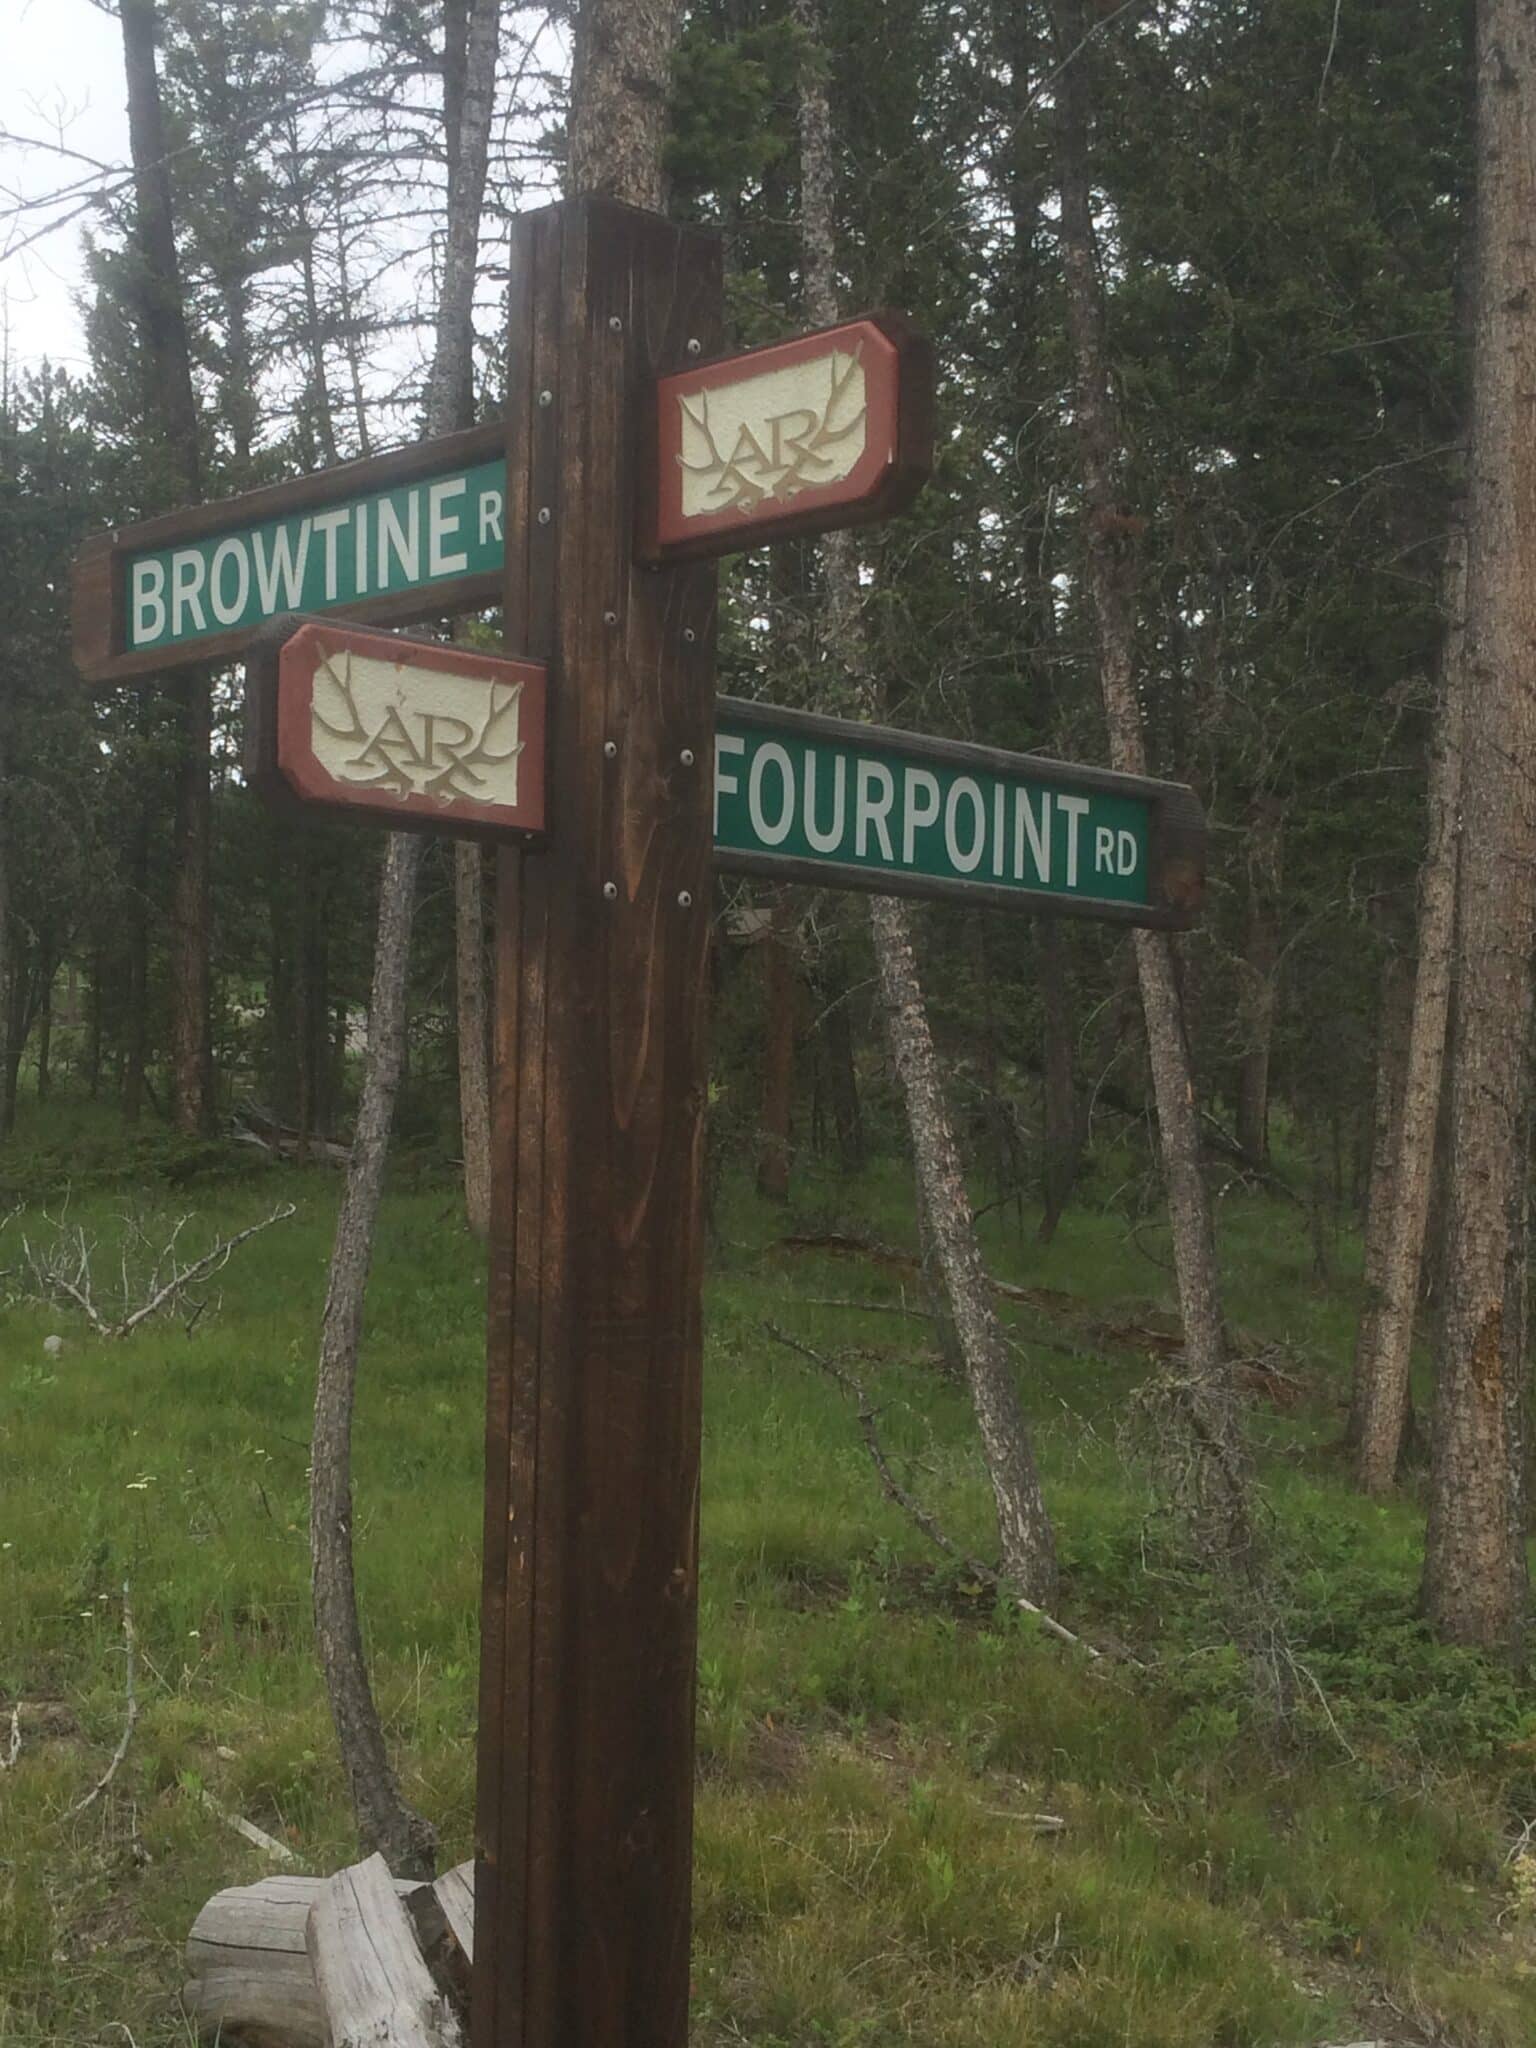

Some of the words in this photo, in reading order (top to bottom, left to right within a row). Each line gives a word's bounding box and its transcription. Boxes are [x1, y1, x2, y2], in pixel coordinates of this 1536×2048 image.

[132, 477, 468, 645] BROWTINE
[478, 489, 504, 546] R
[712, 733, 1090, 887] FOURPOINT
[1095, 826, 1138, 876] RD
